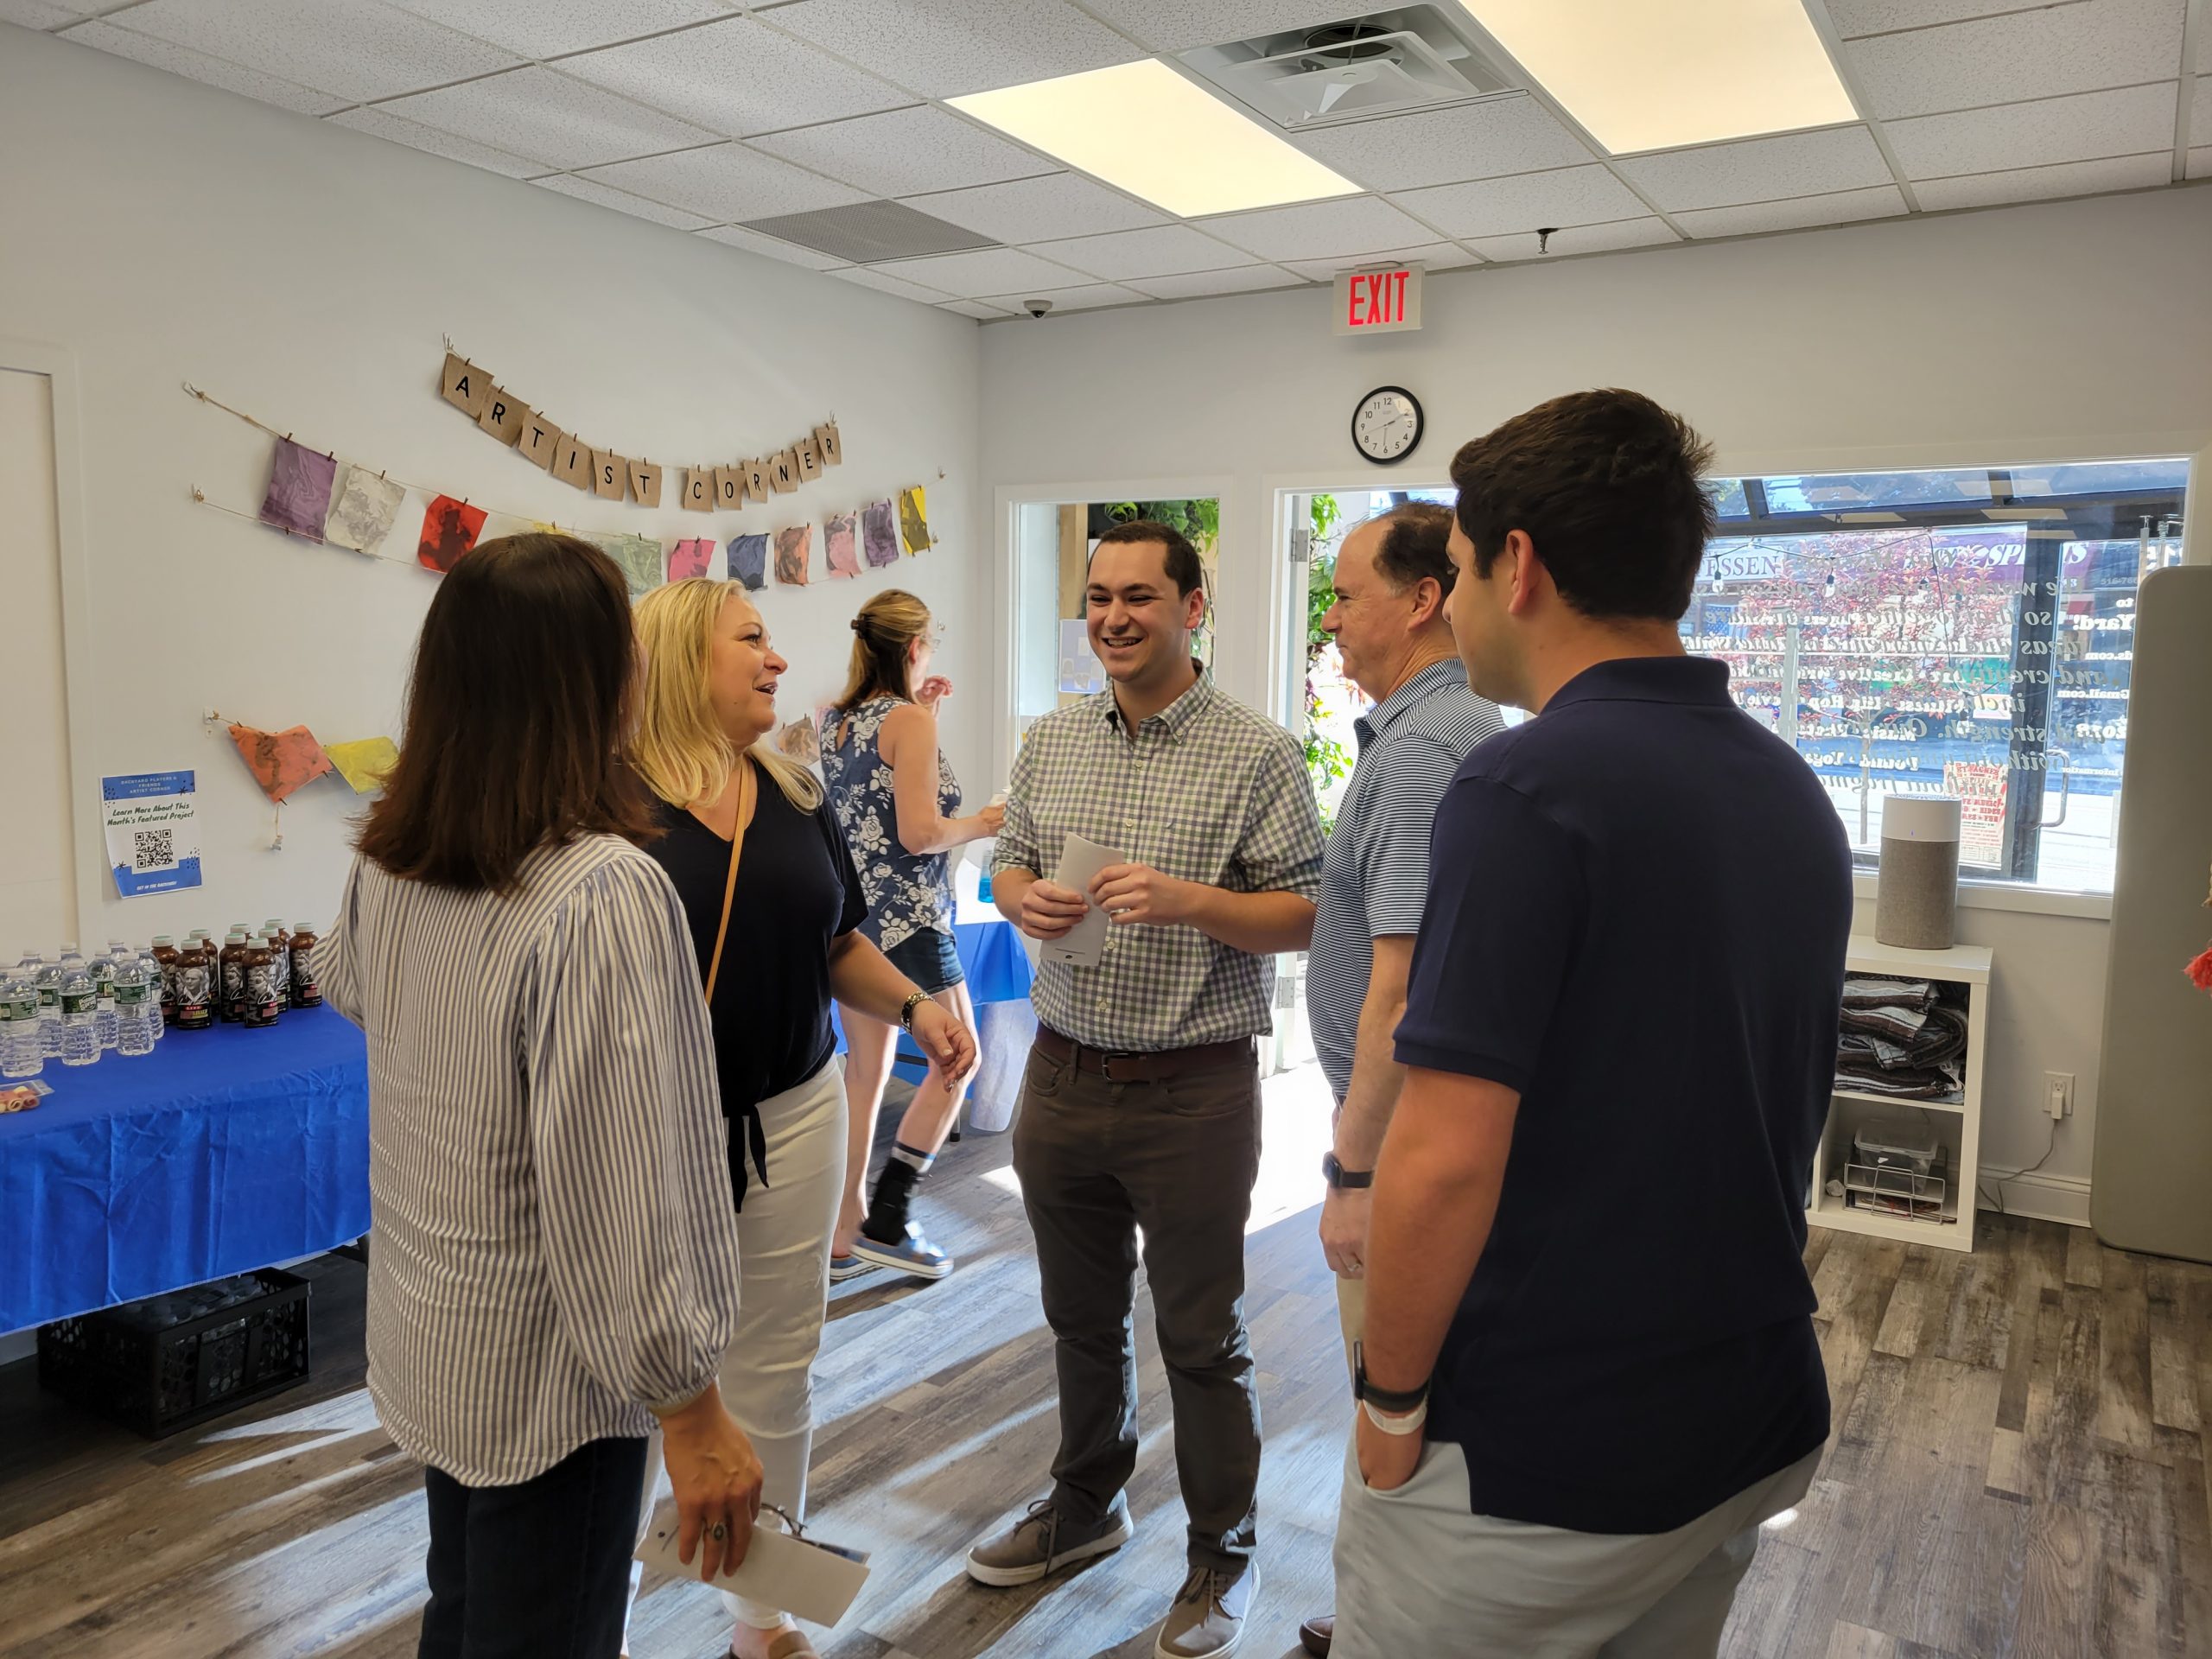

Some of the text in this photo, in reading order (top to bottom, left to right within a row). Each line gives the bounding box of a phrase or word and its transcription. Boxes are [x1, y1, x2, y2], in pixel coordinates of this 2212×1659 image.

[1349, 271, 1410, 326] EXIT
[455, 376, 835, 499] ARTIST CORNER
[1403, 433, 1408, 442] 4
[1698, 556, 1778, 577] ESSEN
[153, 803, 174, 812] About
[107, 810, 194, 826] Month's Featured Project
